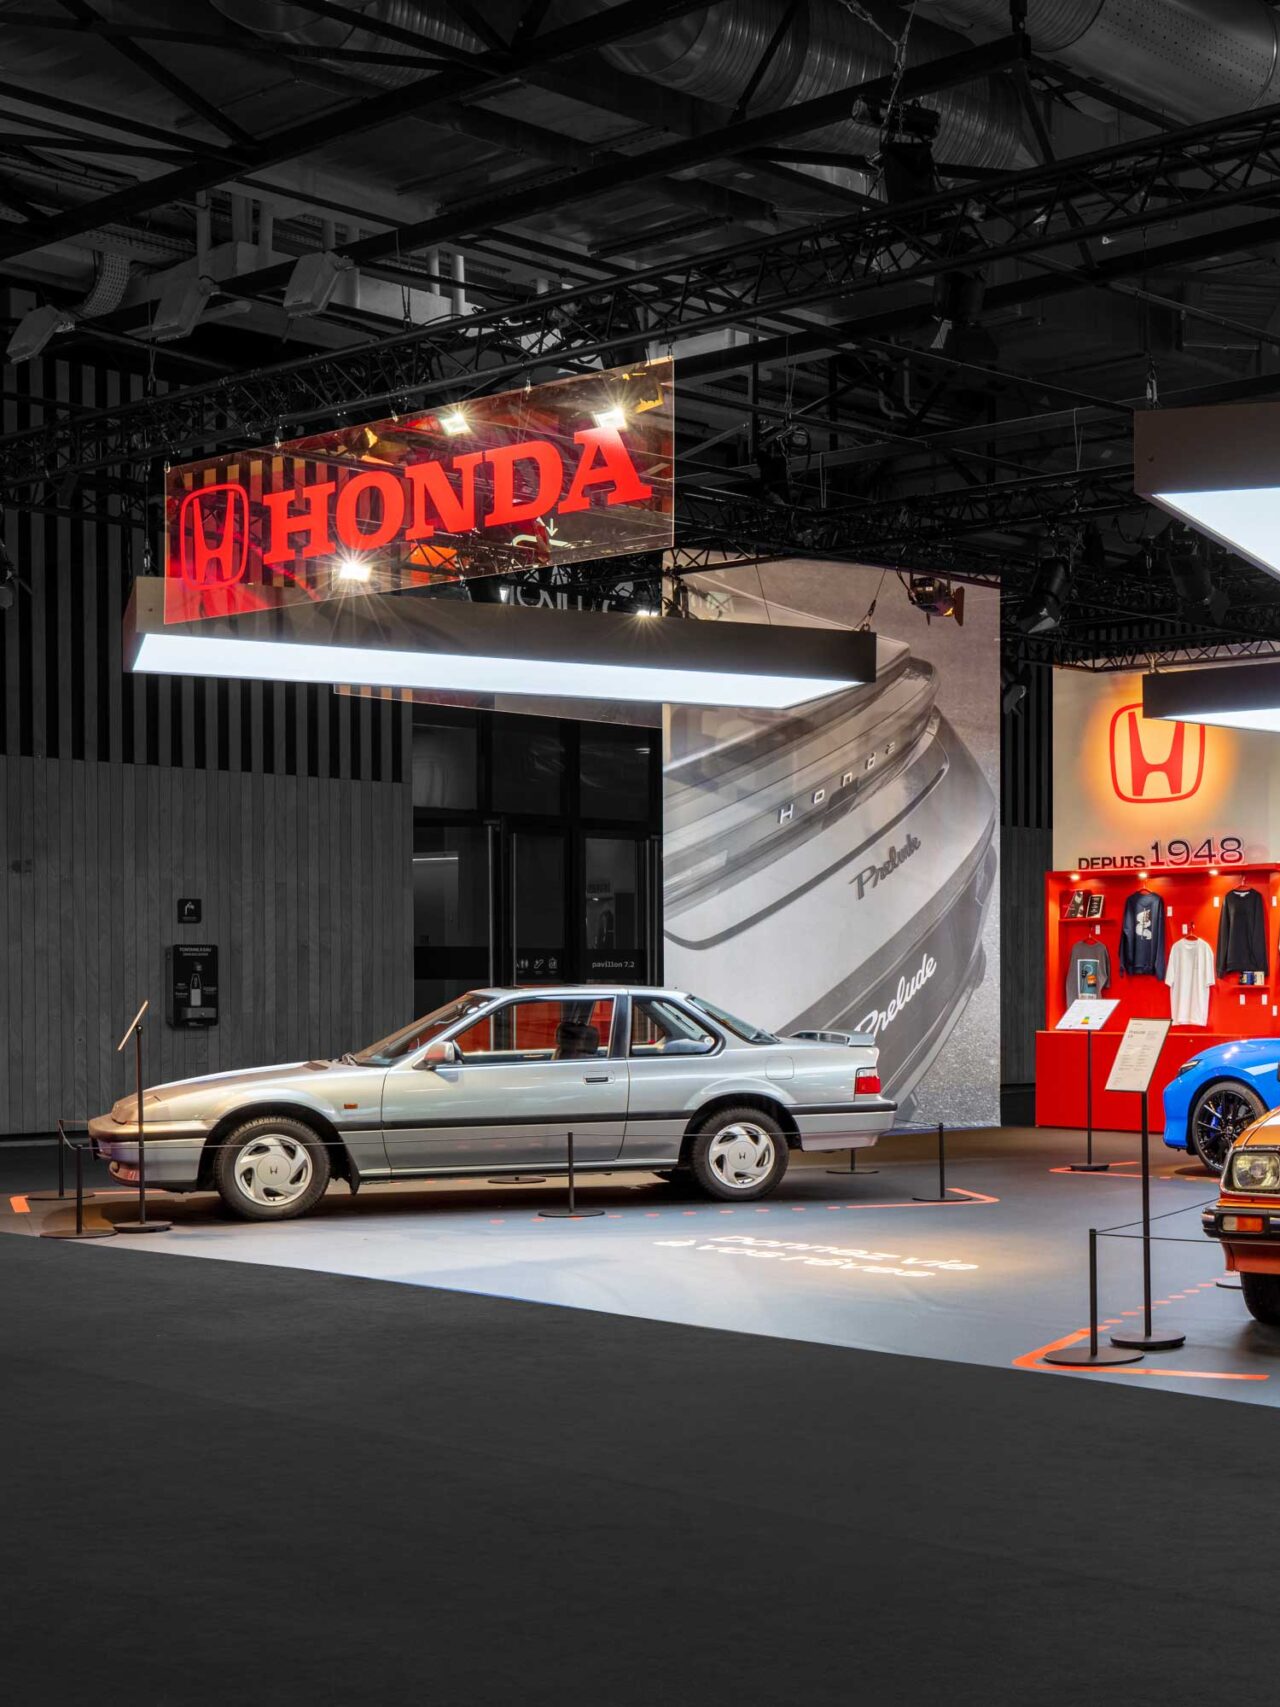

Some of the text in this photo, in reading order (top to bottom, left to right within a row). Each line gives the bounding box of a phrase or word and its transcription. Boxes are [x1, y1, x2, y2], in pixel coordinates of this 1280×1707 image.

[262, 427, 652, 564] HONDA
[849, 833, 922, 901] Prelude
[1078, 837, 1244, 869] DEPUIS 1948
[592, 960, 635, 969] pavillon 7.2
